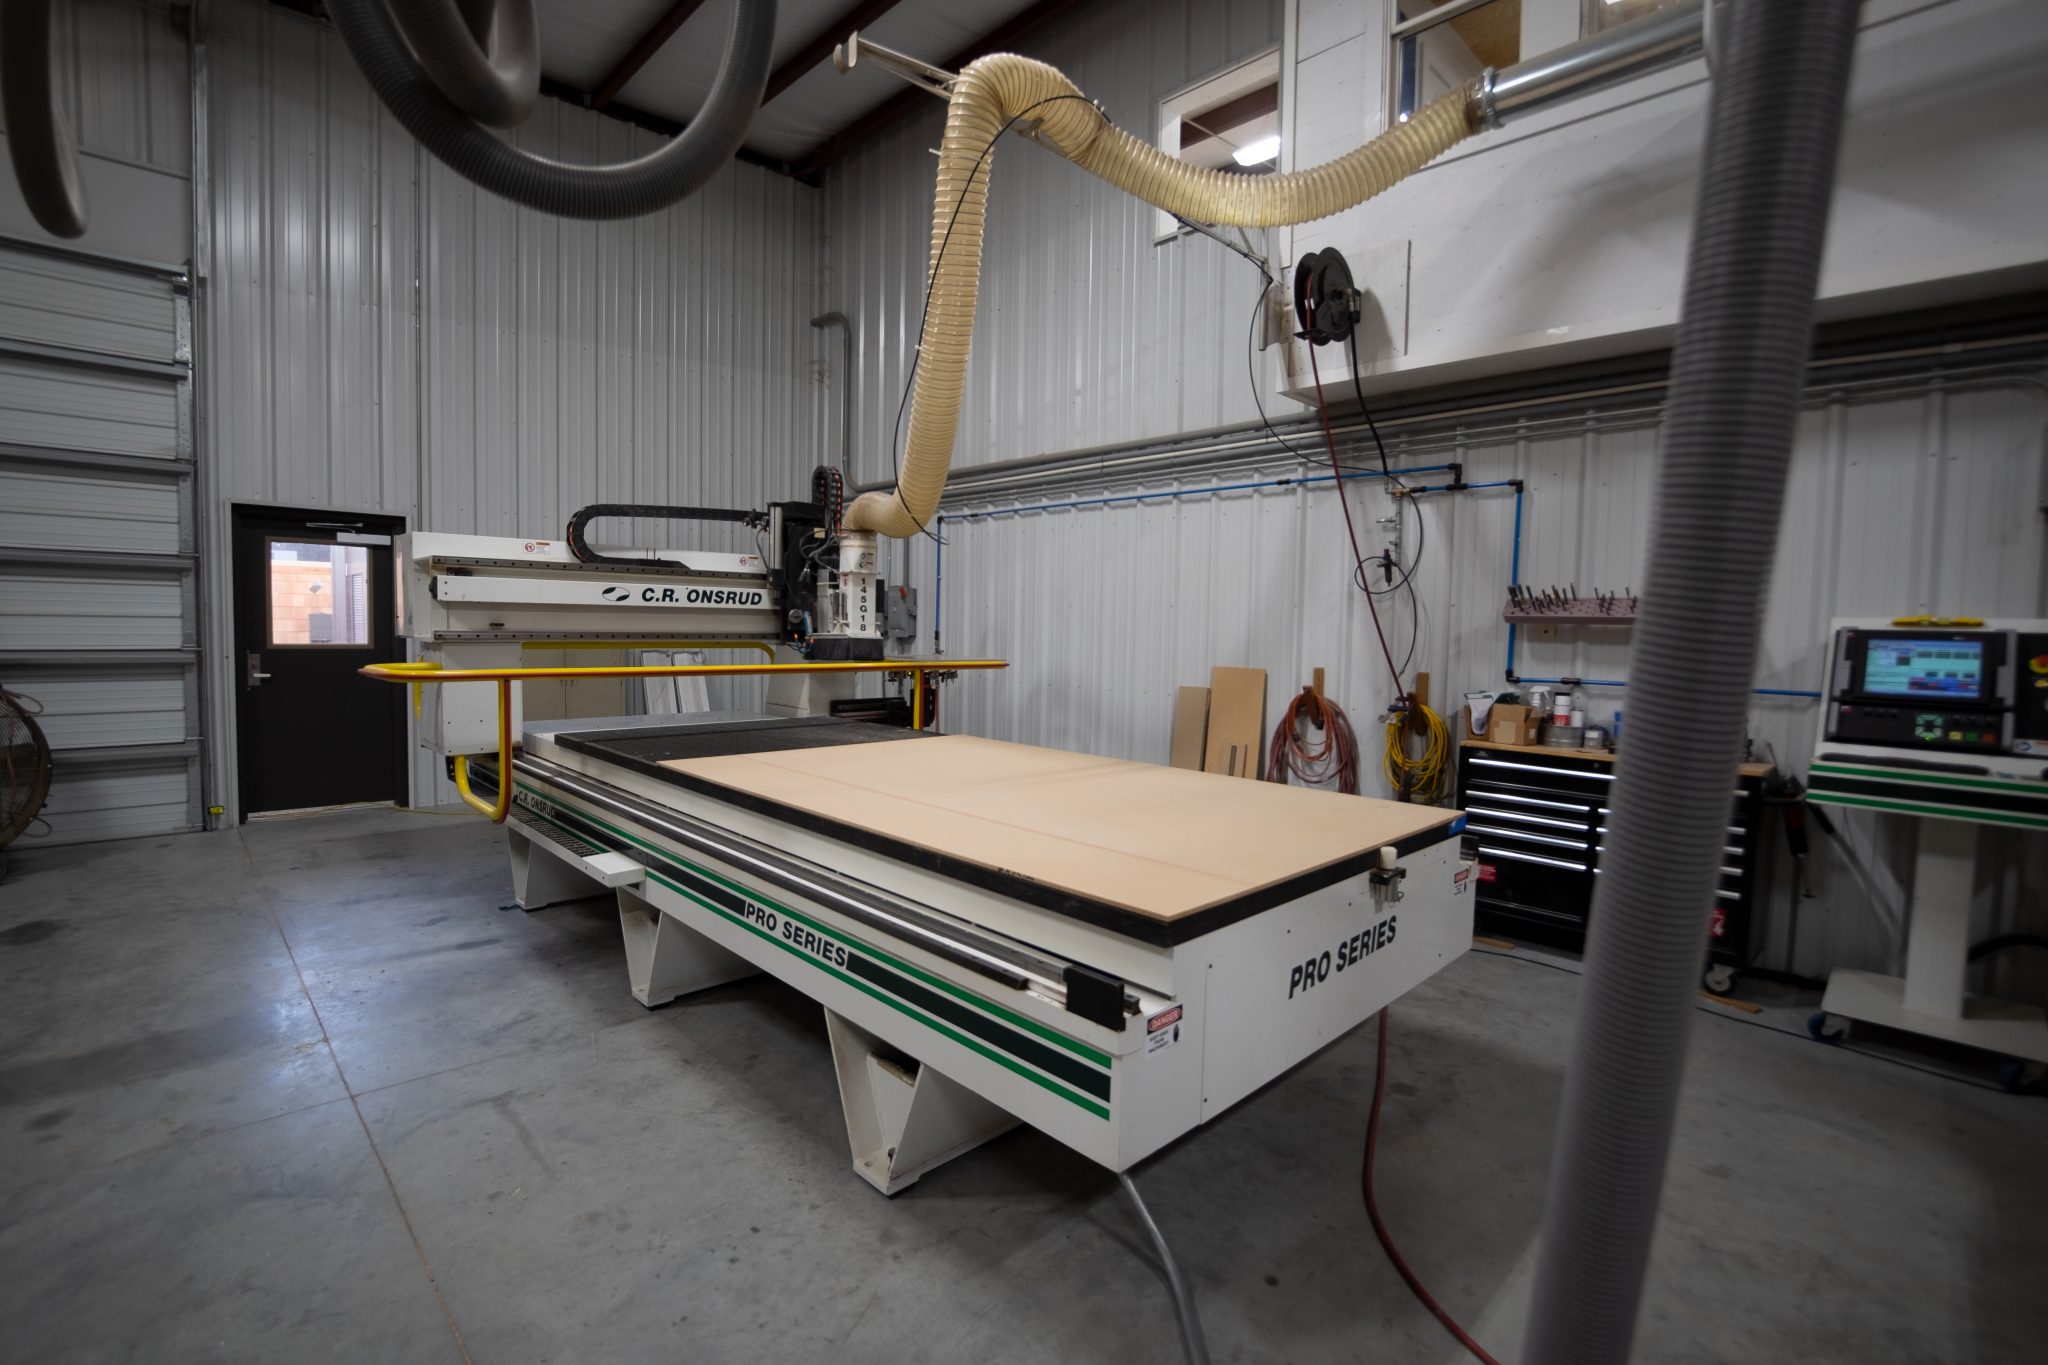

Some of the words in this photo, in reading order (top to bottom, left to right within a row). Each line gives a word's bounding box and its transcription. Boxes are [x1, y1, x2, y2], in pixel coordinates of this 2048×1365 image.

[641, 587, 680, 603] C.R.
[686, 589, 763, 606] ONSRUD
[859, 577, 867, 632] 145G18
[746, 902, 777, 931] PRO
[782, 921, 846, 967] SERIES
[1288, 950, 1331, 1000] PRO
[1336, 915, 1397, 973] SERIES
